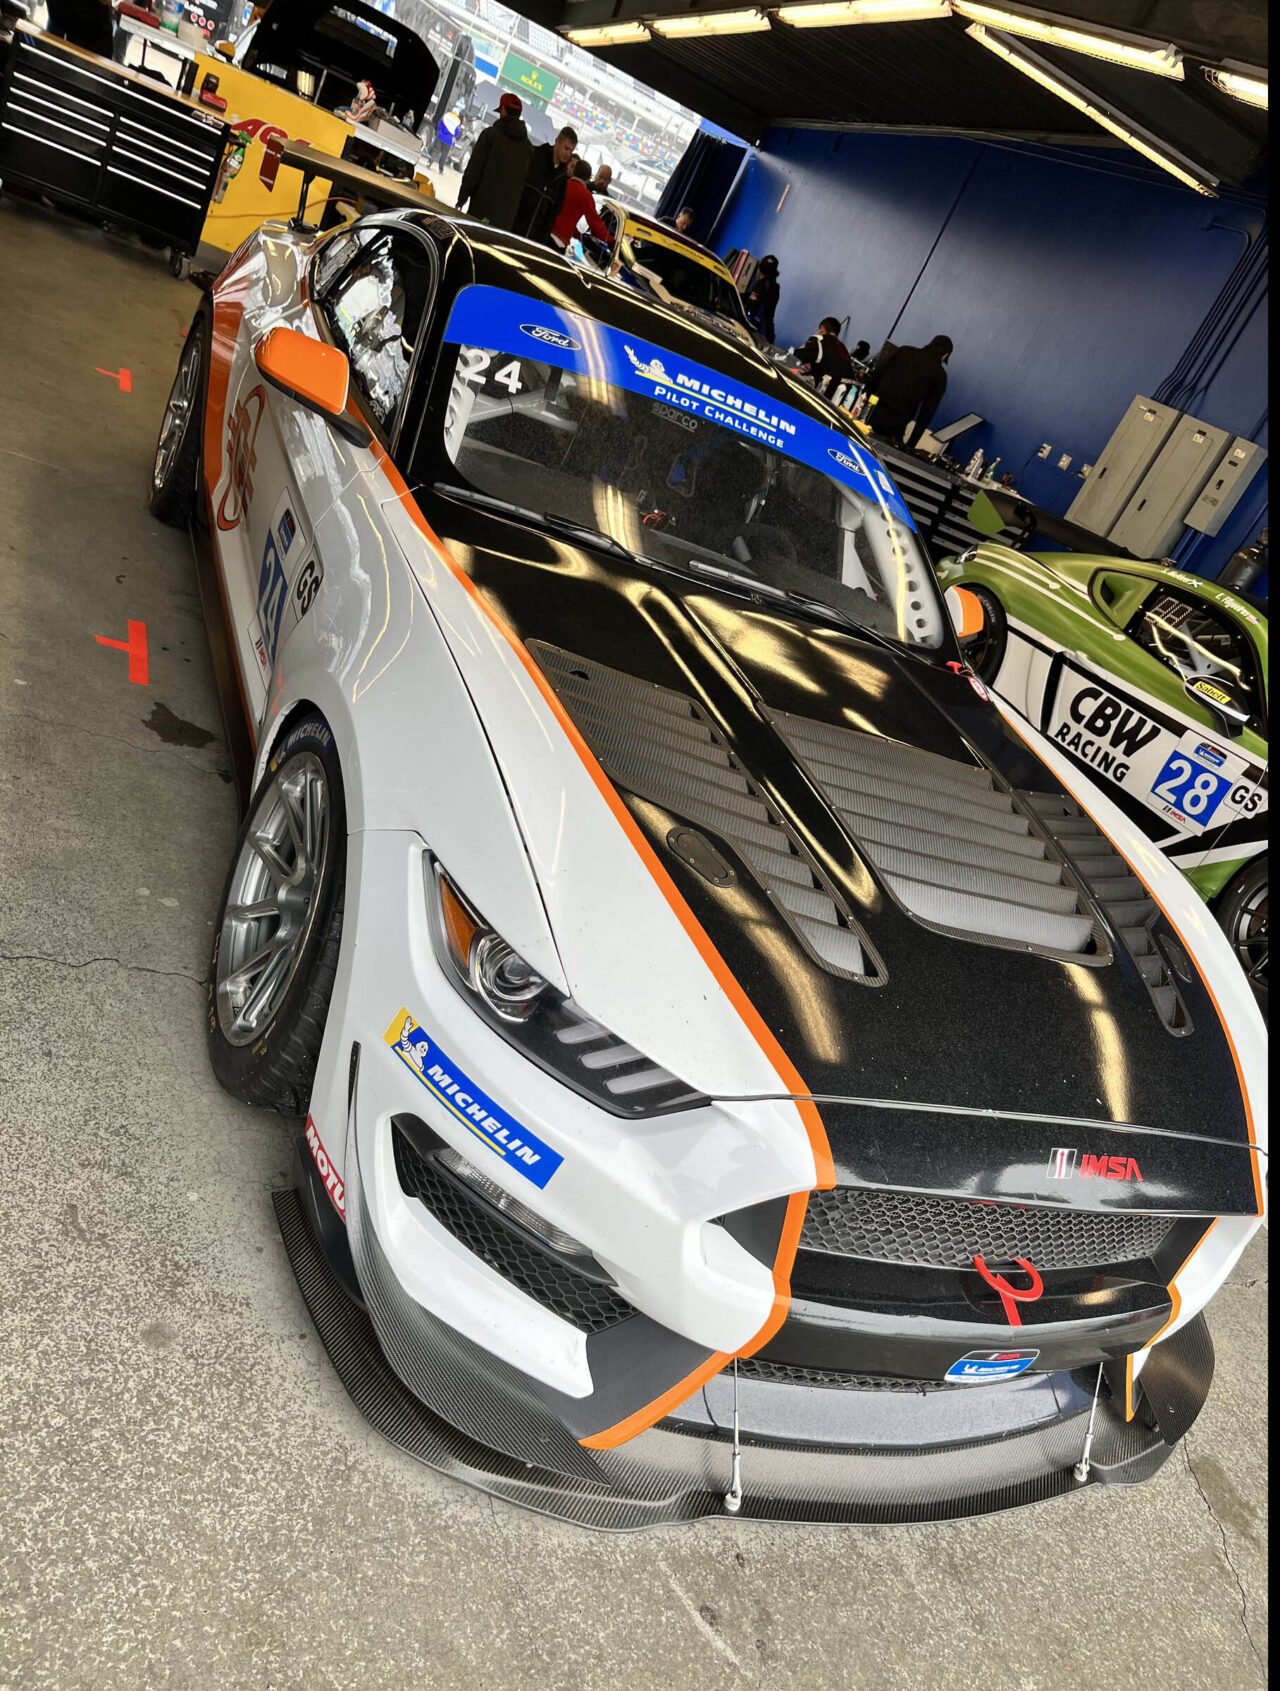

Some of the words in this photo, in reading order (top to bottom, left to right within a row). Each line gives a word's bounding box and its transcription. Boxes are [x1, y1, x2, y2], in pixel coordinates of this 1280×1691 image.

[520, 73, 543, 92] ROLEX
[531, 326, 570, 347] Ford
[459, 348, 523, 394] 24
[651, 402, 698, 430] sparco
[654, 385, 699, 410] PILOT
[704, 405, 785, 449] CHALLENGE
[676, 373, 796, 436] MICHELIN
[835, 451, 861, 473] Ford
[297, 559, 320, 617] GS
[287, 722, 331, 750] MICHELIN
[1069, 686, 1162, 758] CBW
[1054, 721, 1131, 784] RACING
[1153, 758, 1219, 817] 28
[1230, 784, 1263, 814] GS
[427, 1064, 542, 1166] MICHELIN
[306, 1125, 345, 1215] MOTU
[1079, 1154, 1143, 1182] IMSA
